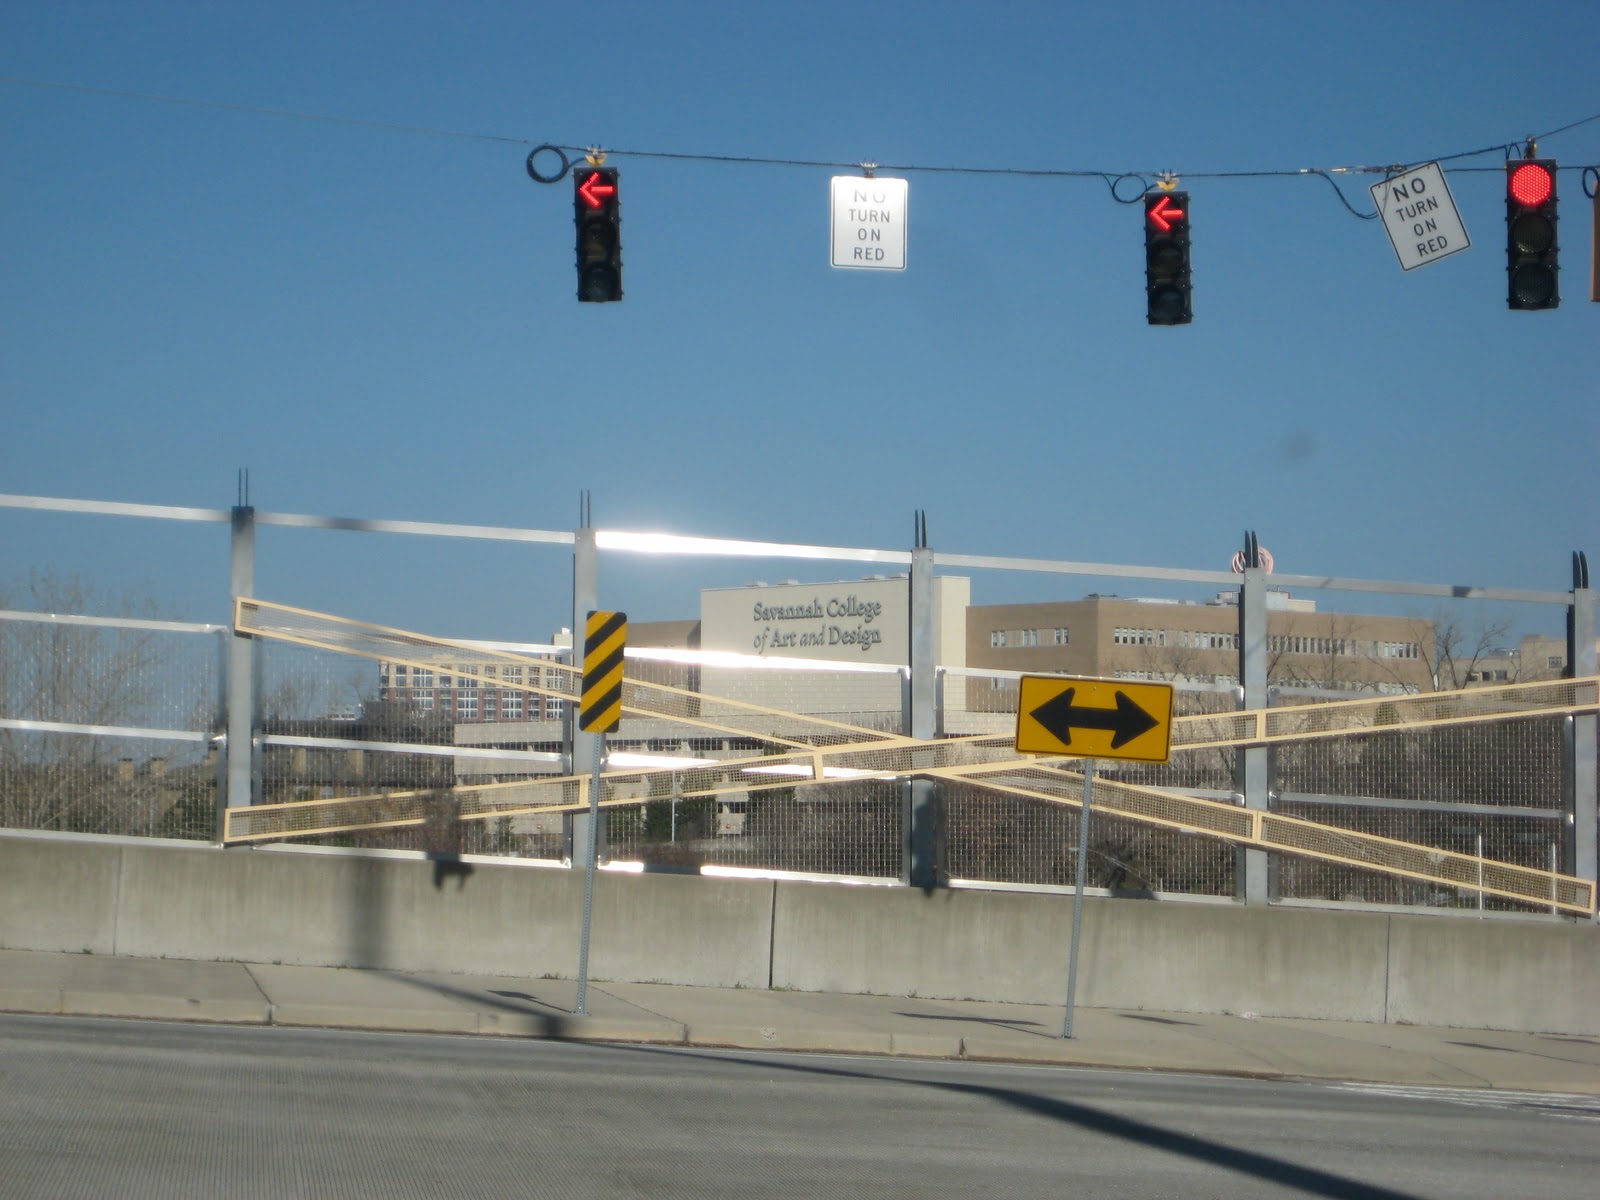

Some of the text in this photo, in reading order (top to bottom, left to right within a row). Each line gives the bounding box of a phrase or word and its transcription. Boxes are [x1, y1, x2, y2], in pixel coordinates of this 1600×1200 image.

[854, 189, 886, 204] NO
[1392, 178, 1426, 202] NO
[848, 208, 890, 223] TURN
[1396, 196, 1439, 222] TURN
[857, 227, 881, 242] ON
[1413, 218, 1438, 237] ON
[853, 246, 885, 261] RED
[1416, 235, 1448, 257] RED
[753, 594, 882, 623] Savannah College
[753, 624, 882, 655] of Art and Design
